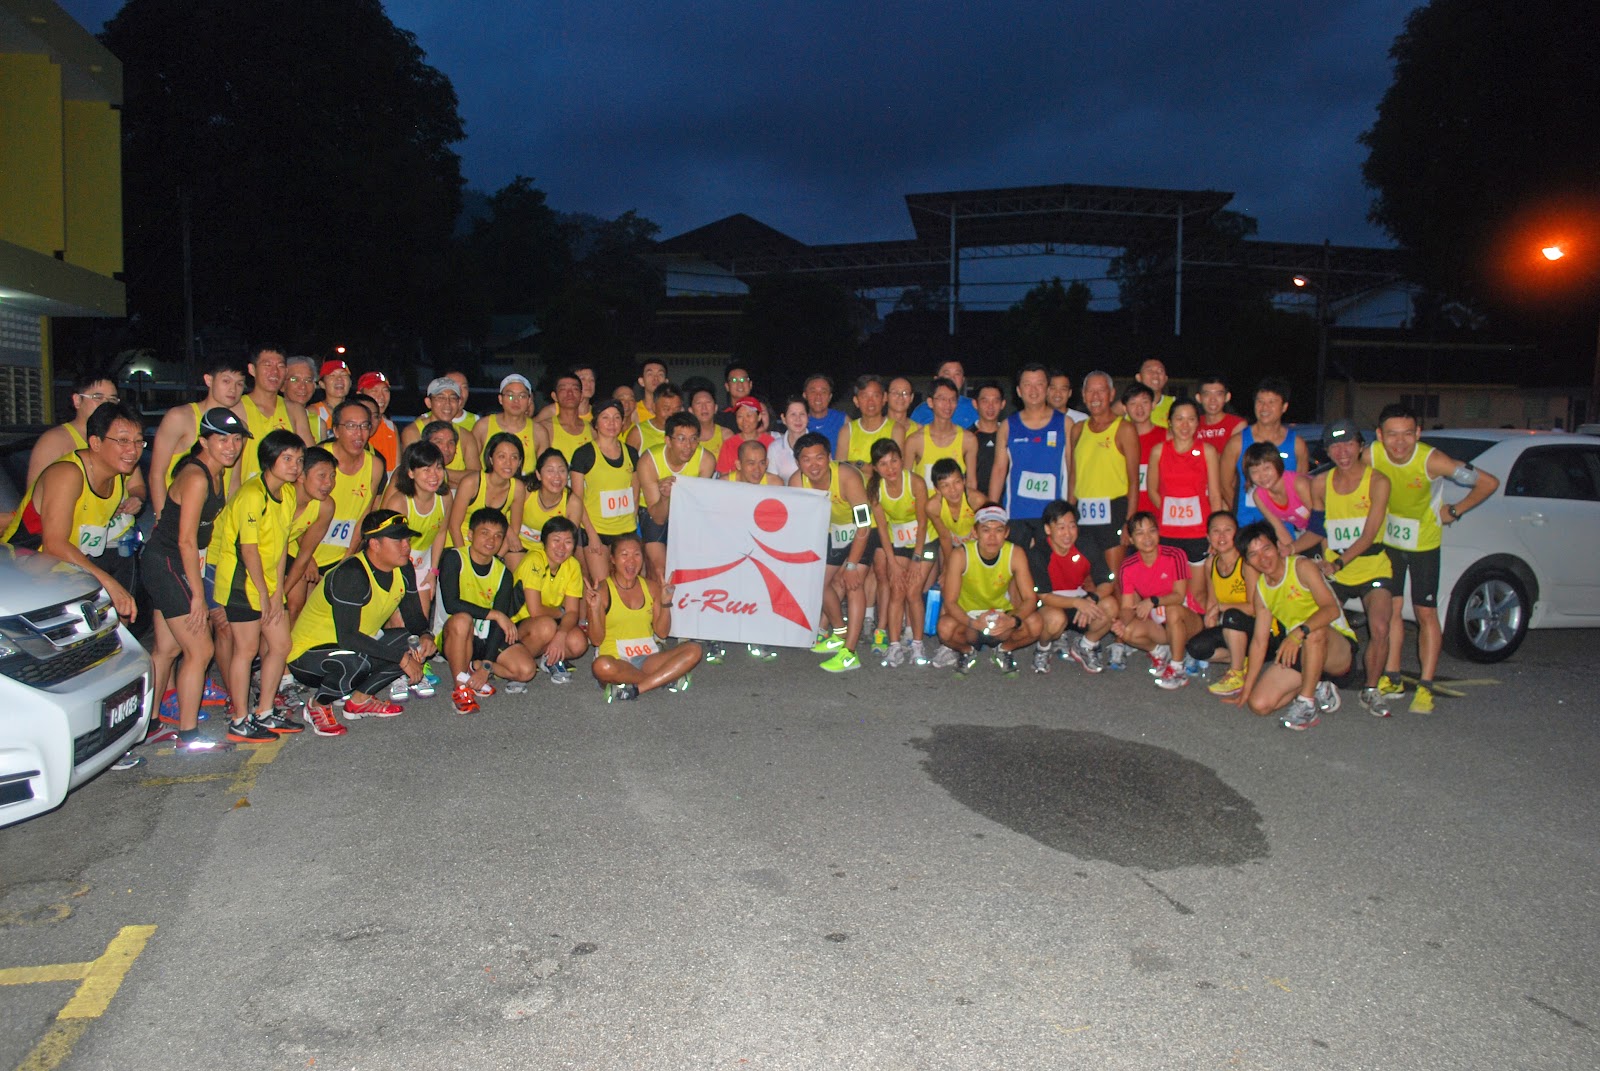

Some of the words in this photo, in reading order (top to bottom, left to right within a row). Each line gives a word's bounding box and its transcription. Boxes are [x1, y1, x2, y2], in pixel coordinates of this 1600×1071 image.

[1026, 478, 1048, 492] 042
[608, 495, 628, 510] 010
[1081, 502, 1105, 519] 669
[1169, 505, 1193, 518] 025
[835, 529, 855, 542] 002
[1334, 526, 1360, 541] 044
[1387, 522, 1411, 540] 023
[678, 589, 758, 615] i-Run
